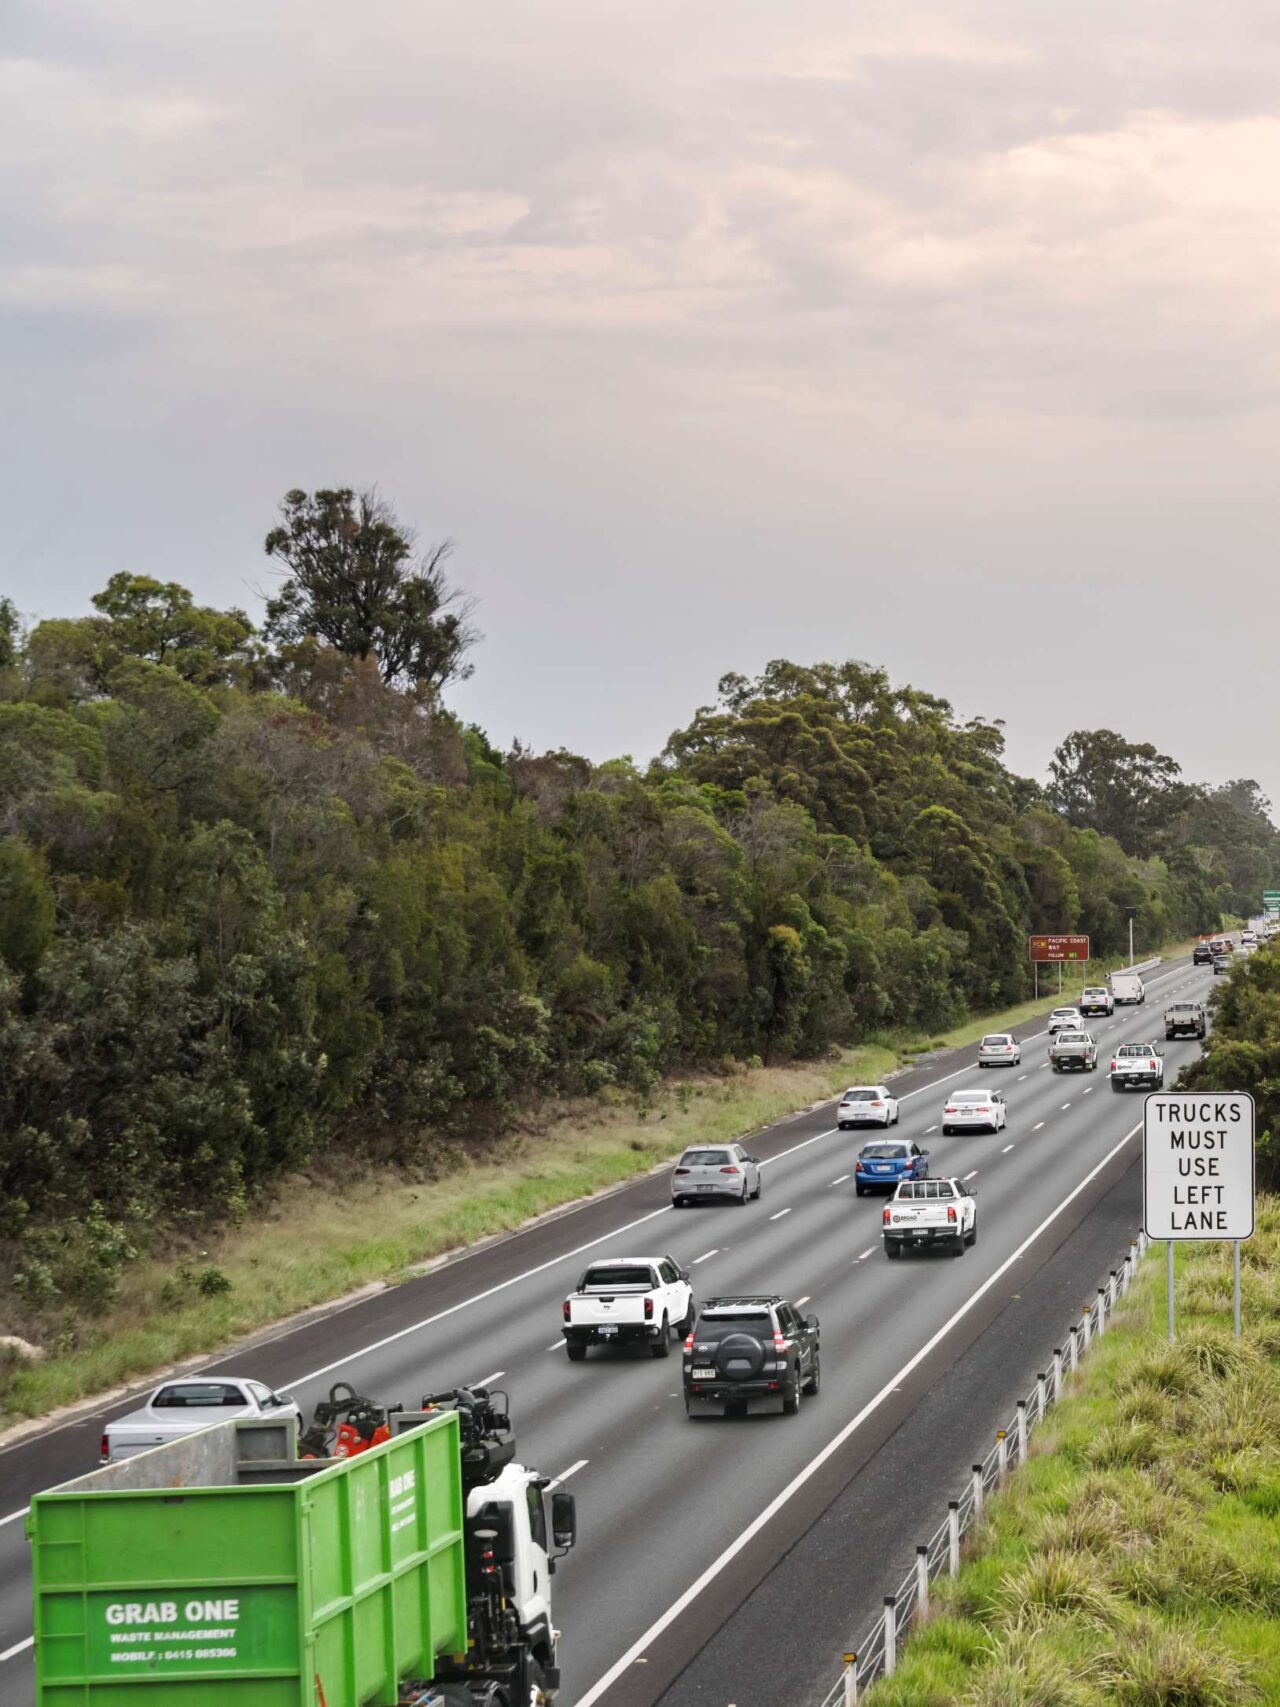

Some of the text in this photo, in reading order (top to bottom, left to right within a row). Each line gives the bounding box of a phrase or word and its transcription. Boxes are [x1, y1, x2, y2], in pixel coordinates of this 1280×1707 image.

[1155, 1103, 1241, 1123] TRUCKS
[1170, 1130, 1228, 1150] MUST
[1178, 1157, 1219, 1177] USE
[1174, 1185, 1225, 1205] LEFT
[1171, 1211, 1228, 1230] LANE
[106, 1599, 240, 1625] GRAB ONE
[110, 1628, 237, 1643] WASTE MANAGEMENT
[164, 1650, 193, 1660] 0415
